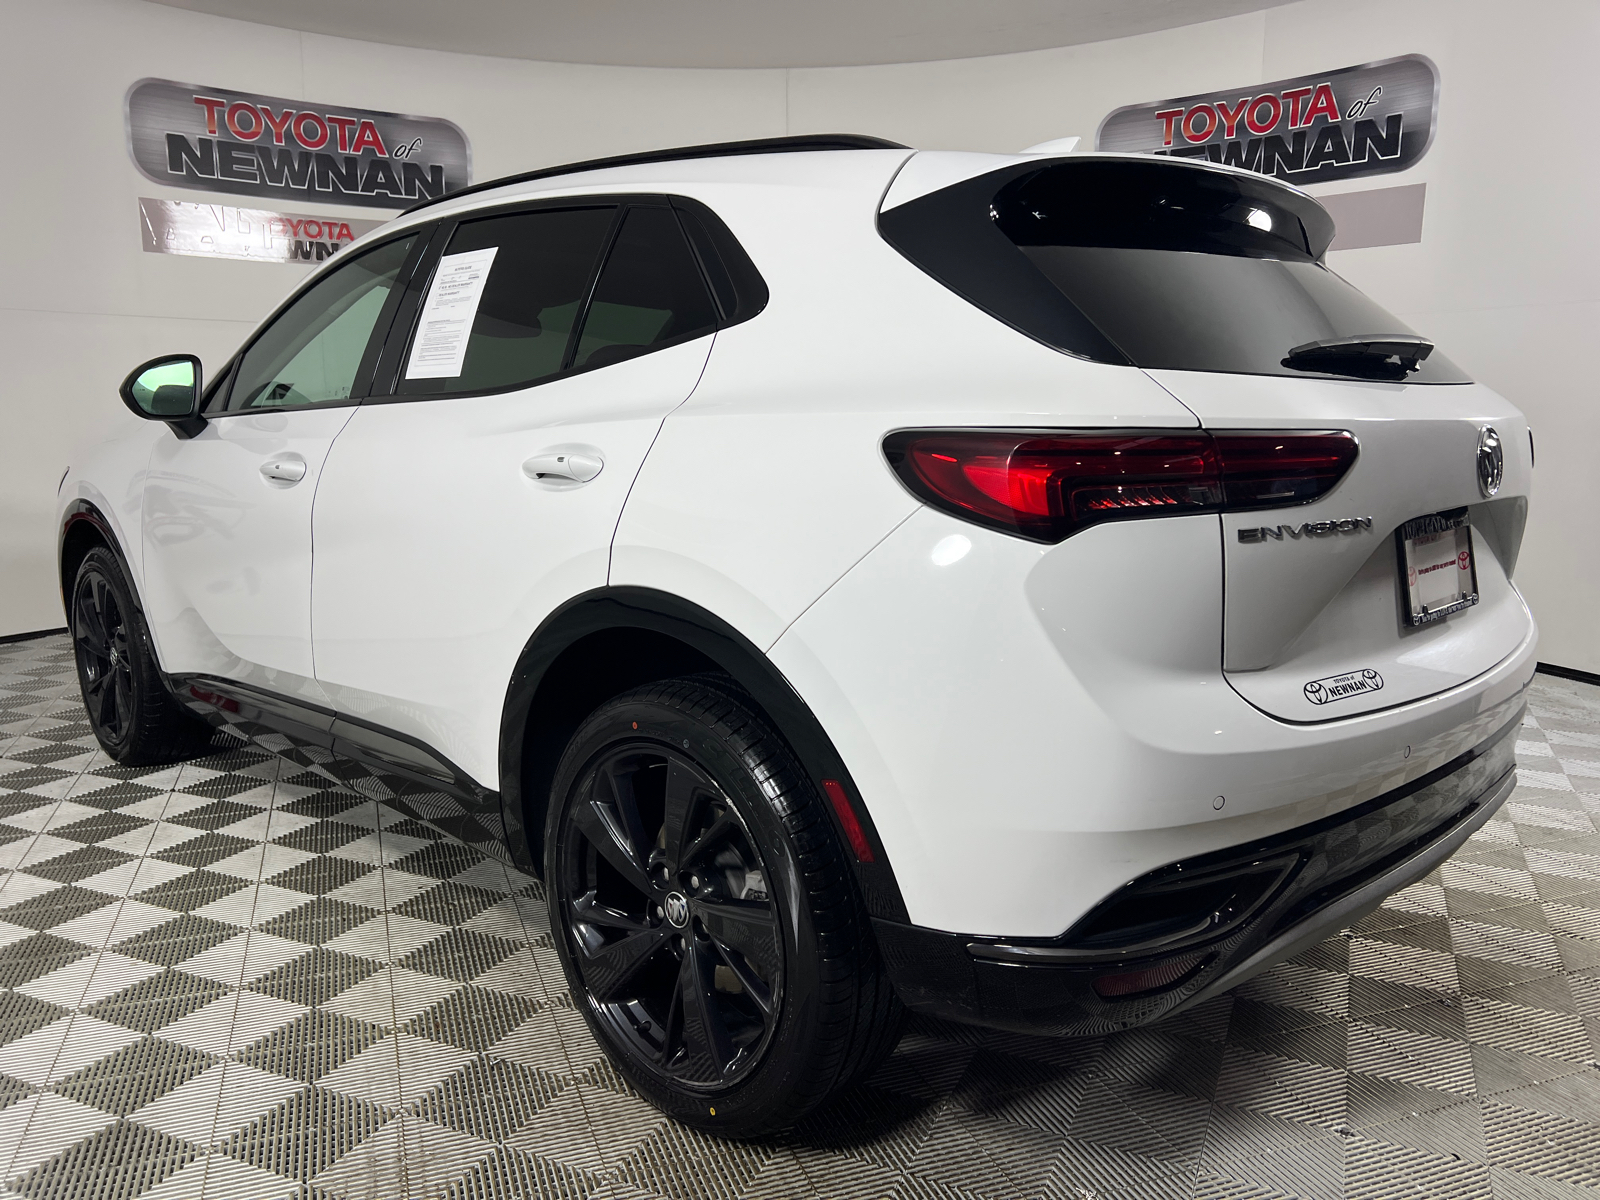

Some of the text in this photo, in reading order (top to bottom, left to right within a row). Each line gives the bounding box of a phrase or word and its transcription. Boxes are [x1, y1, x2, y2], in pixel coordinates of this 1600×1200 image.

[193, 95, 422, 160] TOYOTA of
[1153, 113, 1403, 176] WNAN
[1155, 82, 1383, 148] TOYOTA of
[165, 132, 447, 199] NEWNAN
[267, 217, 354, 241] OYOTA
[1238, 516, 1373, 543] ENVISION
[1328, 680, 1367, 697] NEWNAN
